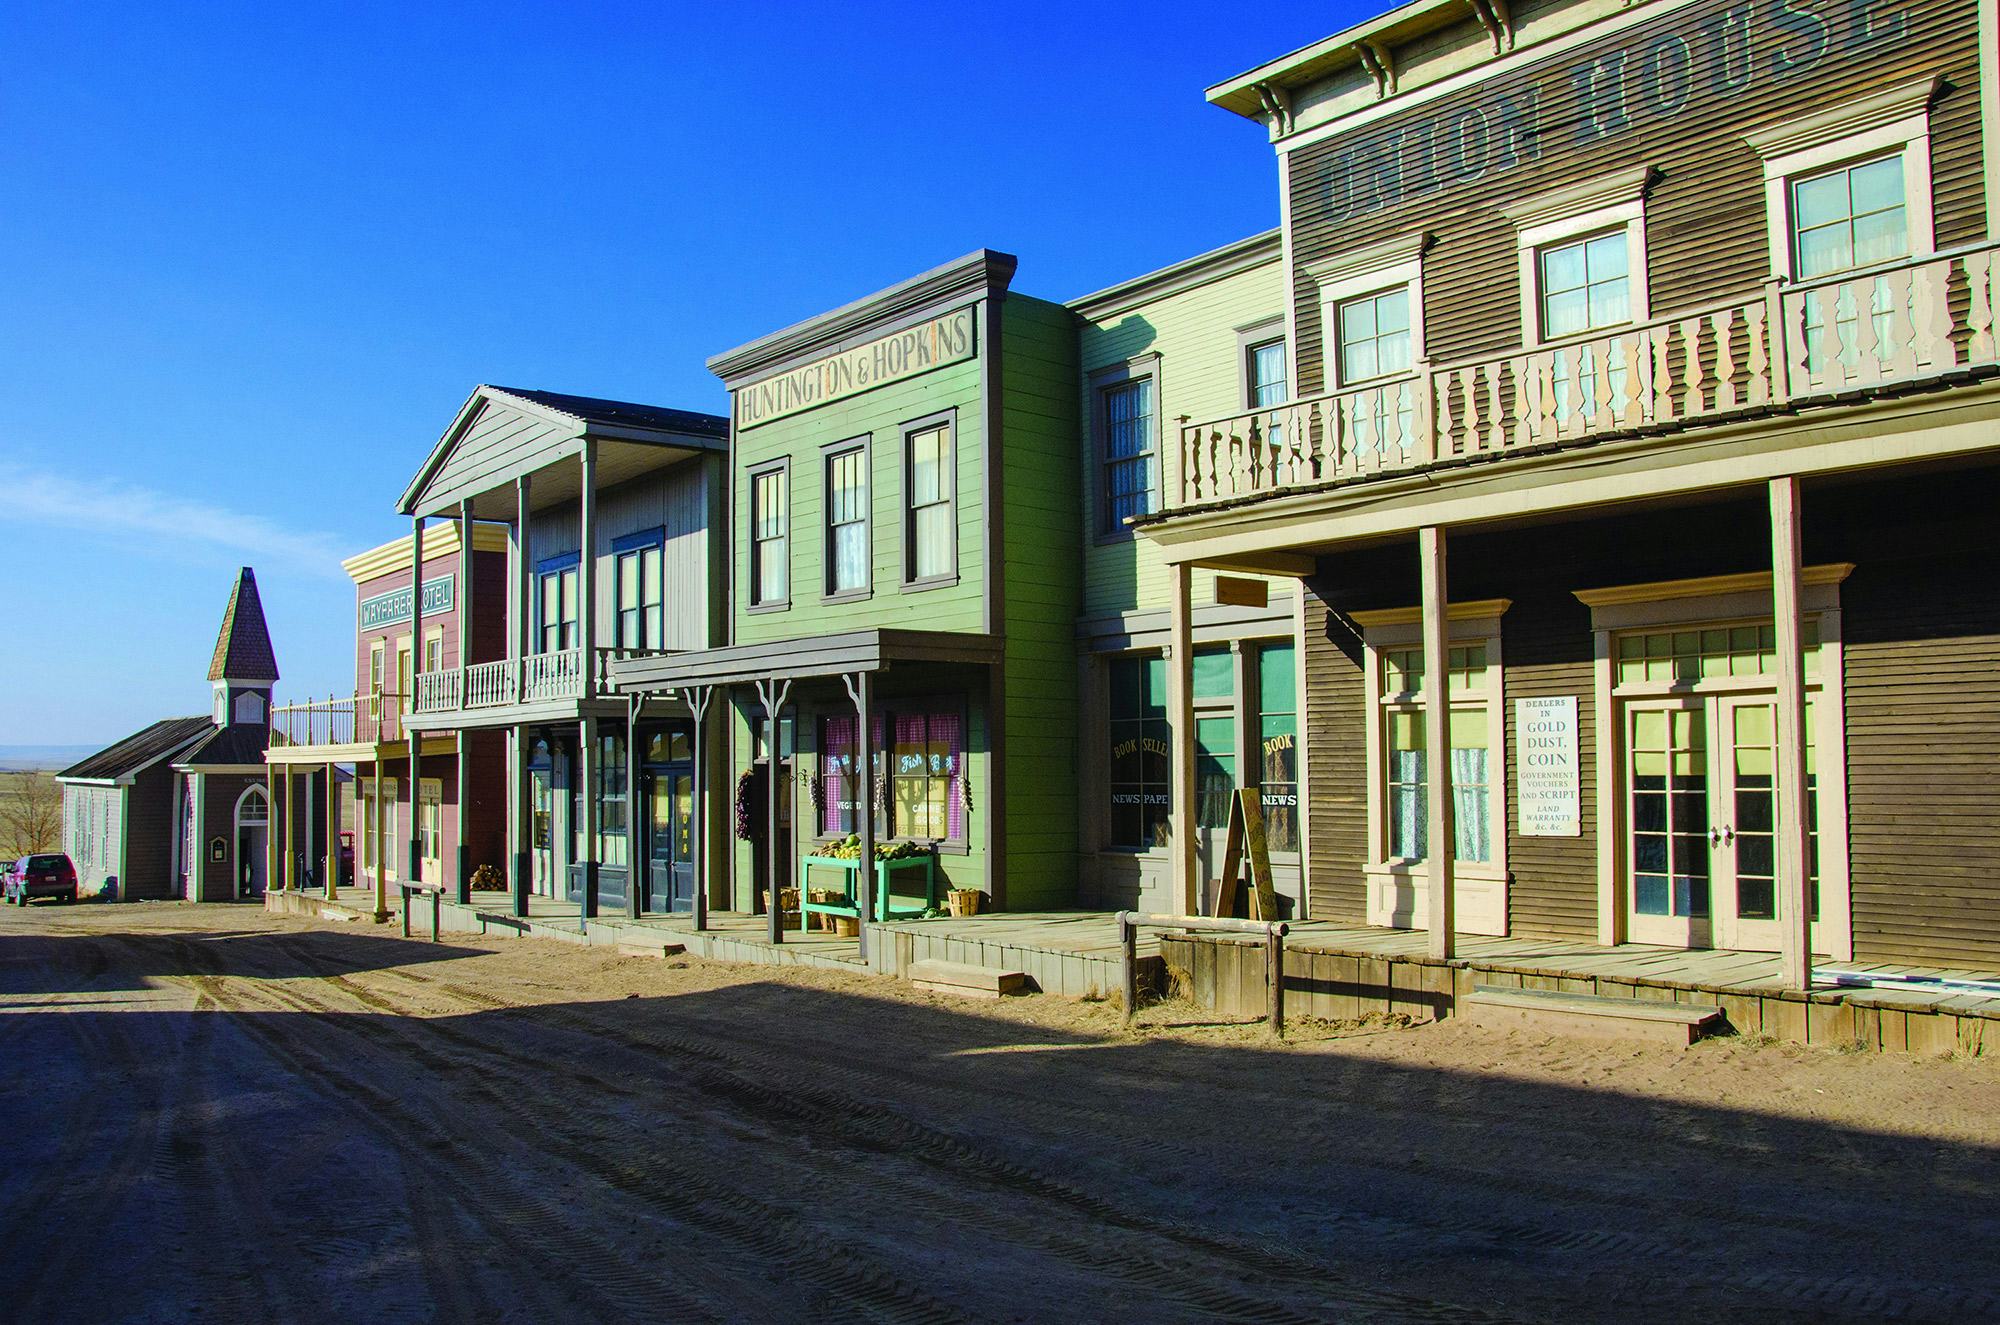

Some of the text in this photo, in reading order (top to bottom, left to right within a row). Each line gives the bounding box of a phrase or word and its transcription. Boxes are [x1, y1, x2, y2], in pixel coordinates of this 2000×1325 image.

[1318, 84, 1543, 224] UNION
[741, 353, 853, 424] HUNTINGTON
[857, 356, 871, 385] &
[363, 584, 449, 624] WAYFARER OTEL
[1525, 700, 1566, 708] DEALERS
[1527, 721, 1566, 733] GOLD
[1113, 738, 1137, 759] BOOK
[1264, 733, 1293, 756] BOOK
[1527, 753, 1567, 766] COIN
[1526, 780, 1569, 788] VOUCHERS
[1112, 794, 1168, 804] NEWS PAPE
[1262, 794, 1297, 806] NEWS
[1520, 790, 1576, 800] AND SCRIPT
[1537, 805, 1560, 813] LAND
[1526, 814, 1572, 822] WARRANTY
